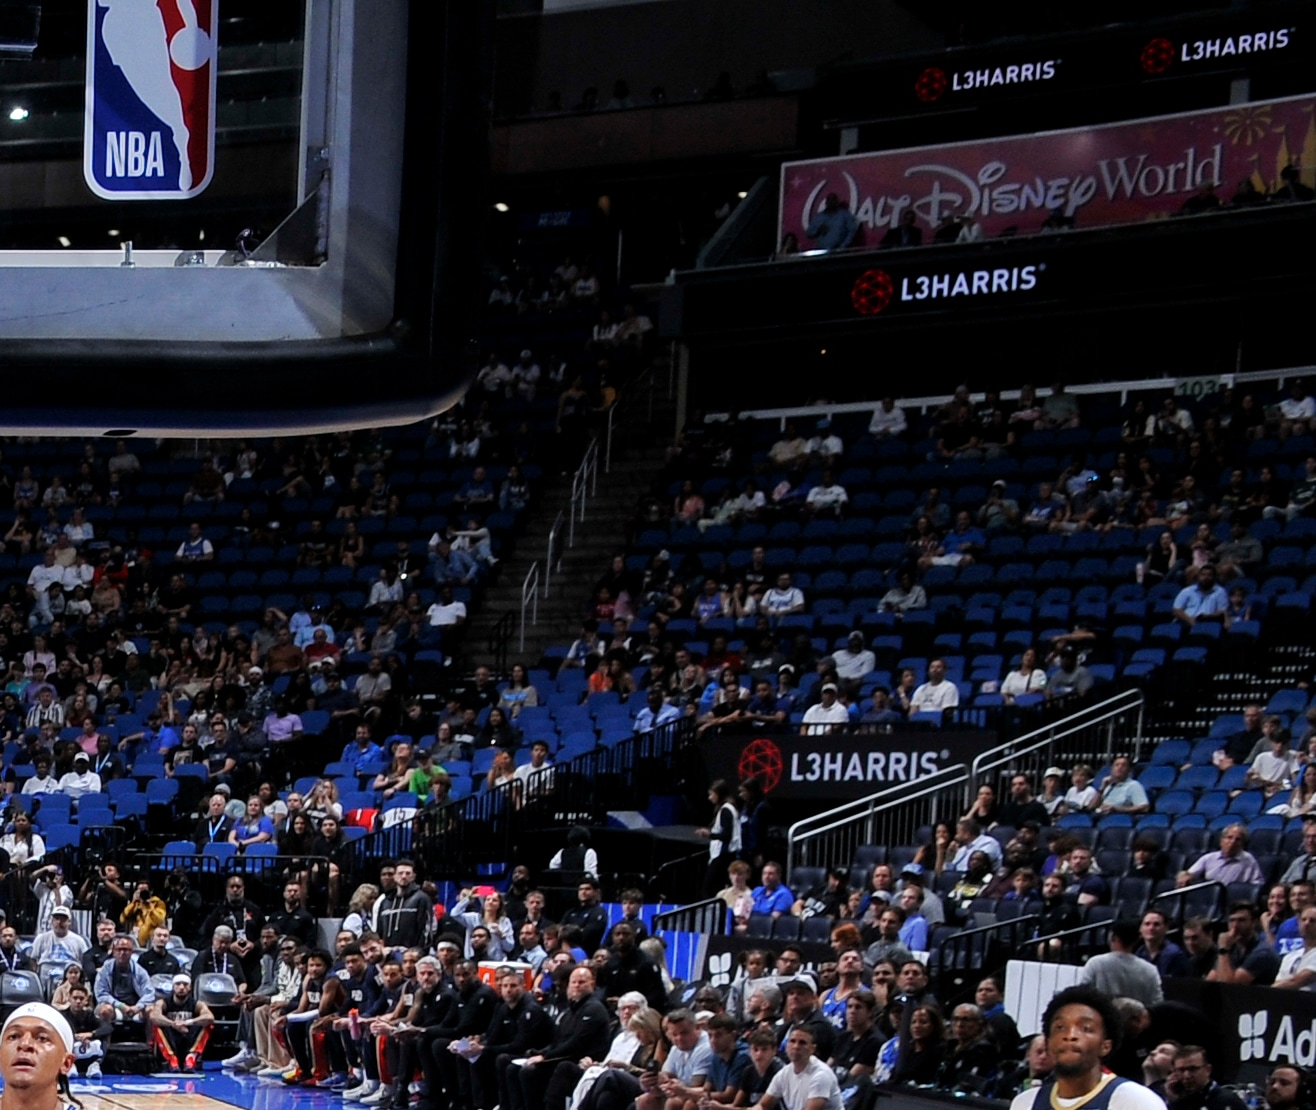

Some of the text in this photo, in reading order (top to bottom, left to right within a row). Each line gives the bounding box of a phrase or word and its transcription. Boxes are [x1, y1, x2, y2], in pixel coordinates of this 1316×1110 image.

[1181, 29, 1289, 61] L3HARRIS
[952, 60, 1055, 91] L3HARRIS
[105, 131, 164, 178] NBA
[1097, 144, 1224, 201] World
[901, 266, 1038, 301] L3HARRIS
[791, 751, 938, 782] L3HARRIS
